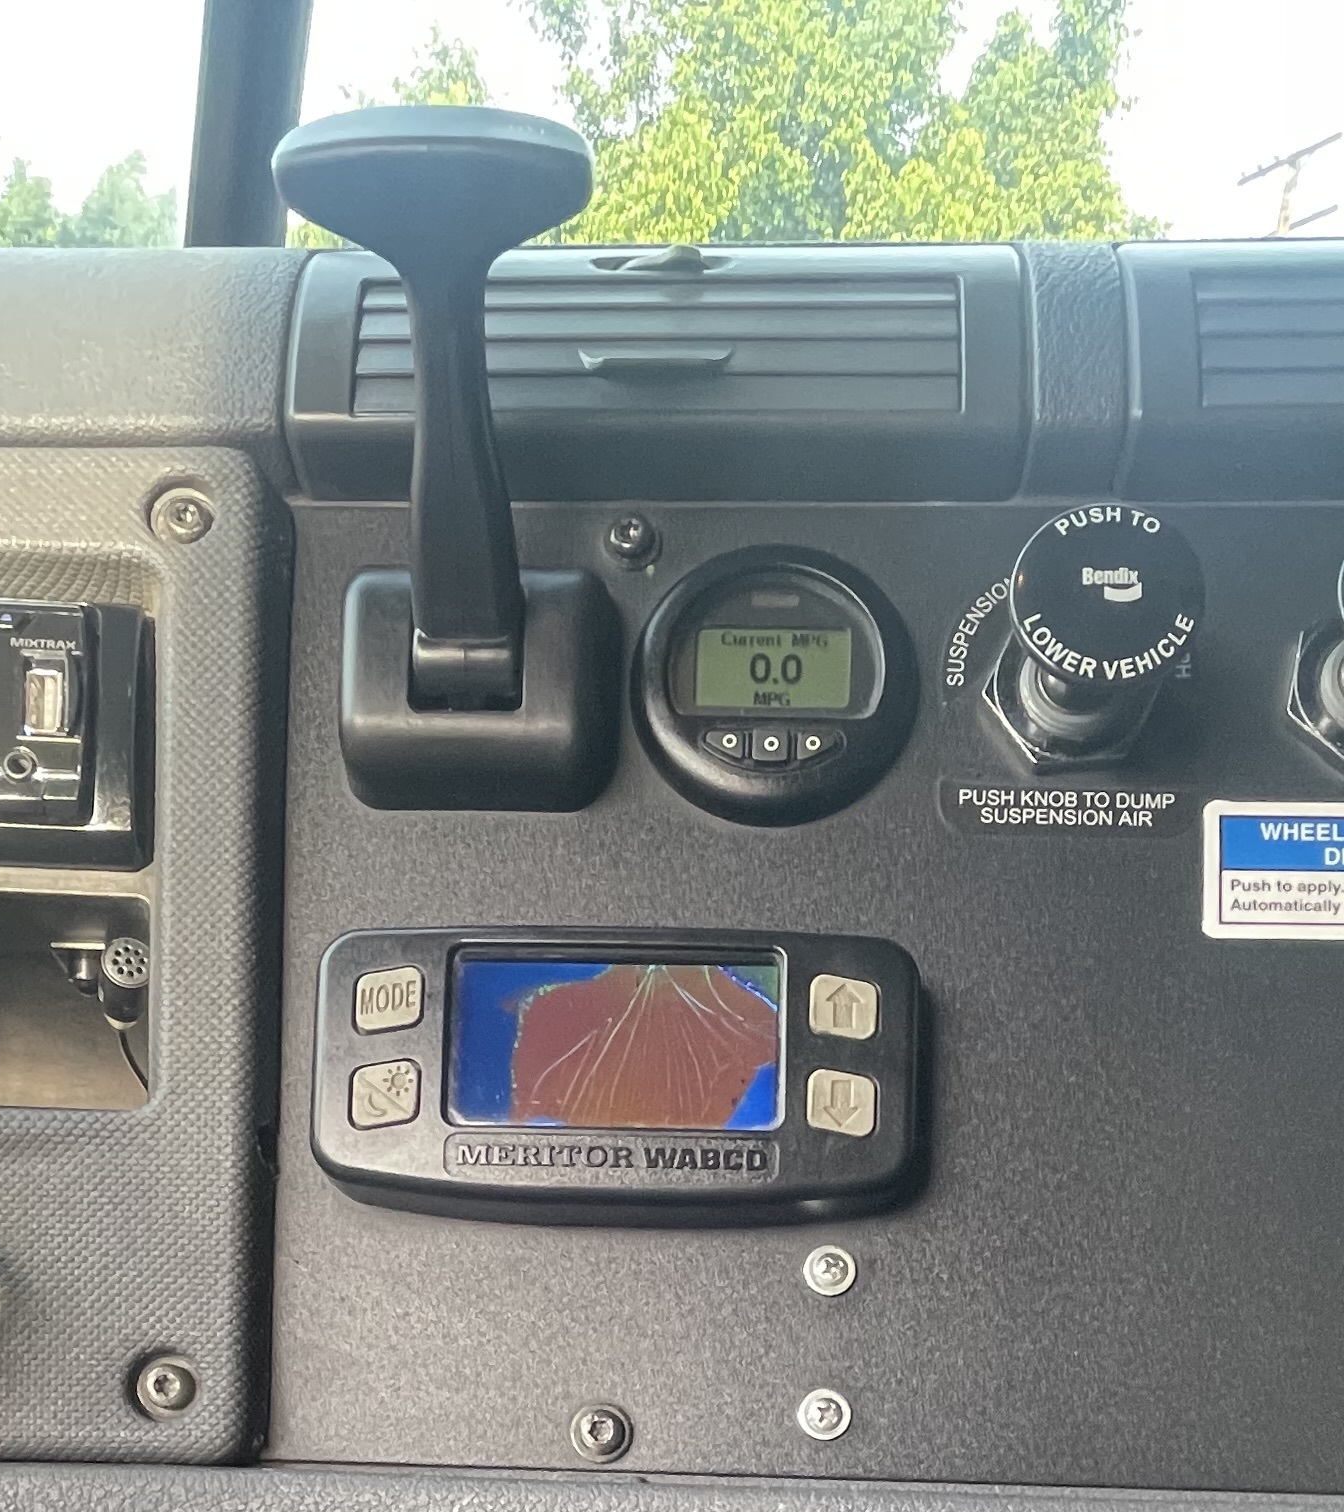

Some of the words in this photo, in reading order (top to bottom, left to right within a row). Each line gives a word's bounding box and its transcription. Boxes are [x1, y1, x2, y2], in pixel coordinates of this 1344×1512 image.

[1054, 506, 1121, 536] PUSH
[1130, 509, 1161, 534] TO
[1082, 567, 1139, 585] Bendix
[10, 637, 76, 649] MIXTRAX
[720, 630, 782, 648] Current
[792, 632, 828, 648] MPG
[1022, 613, 1097, 679] LOWER
[1102, 613, 1195, 680] VEHICLE
[749, 653, 802, 684] 0.0
[753, 691, 791, 706] MPG
[958, 788, 1015, 806] PUSH
[1020, 790, 1078, 808] KNOB
[1082, 791, 1110, 808] TO
[1115, 792, 1176, 809] DUMP
[980, 806, 1113, 826] SUSPENSION
[1117, 810, 1153, 827] AIR
[1230, 879, 1270, 893] Push
[1276, 880, 1293, 894] to
[1298, 881, 1344, 897] apply.
[1230, 898, 1341, 915] Automatically
[359, 980, 417, 1015] MODE
[456, 1144, 633, 1169] MERITOR
